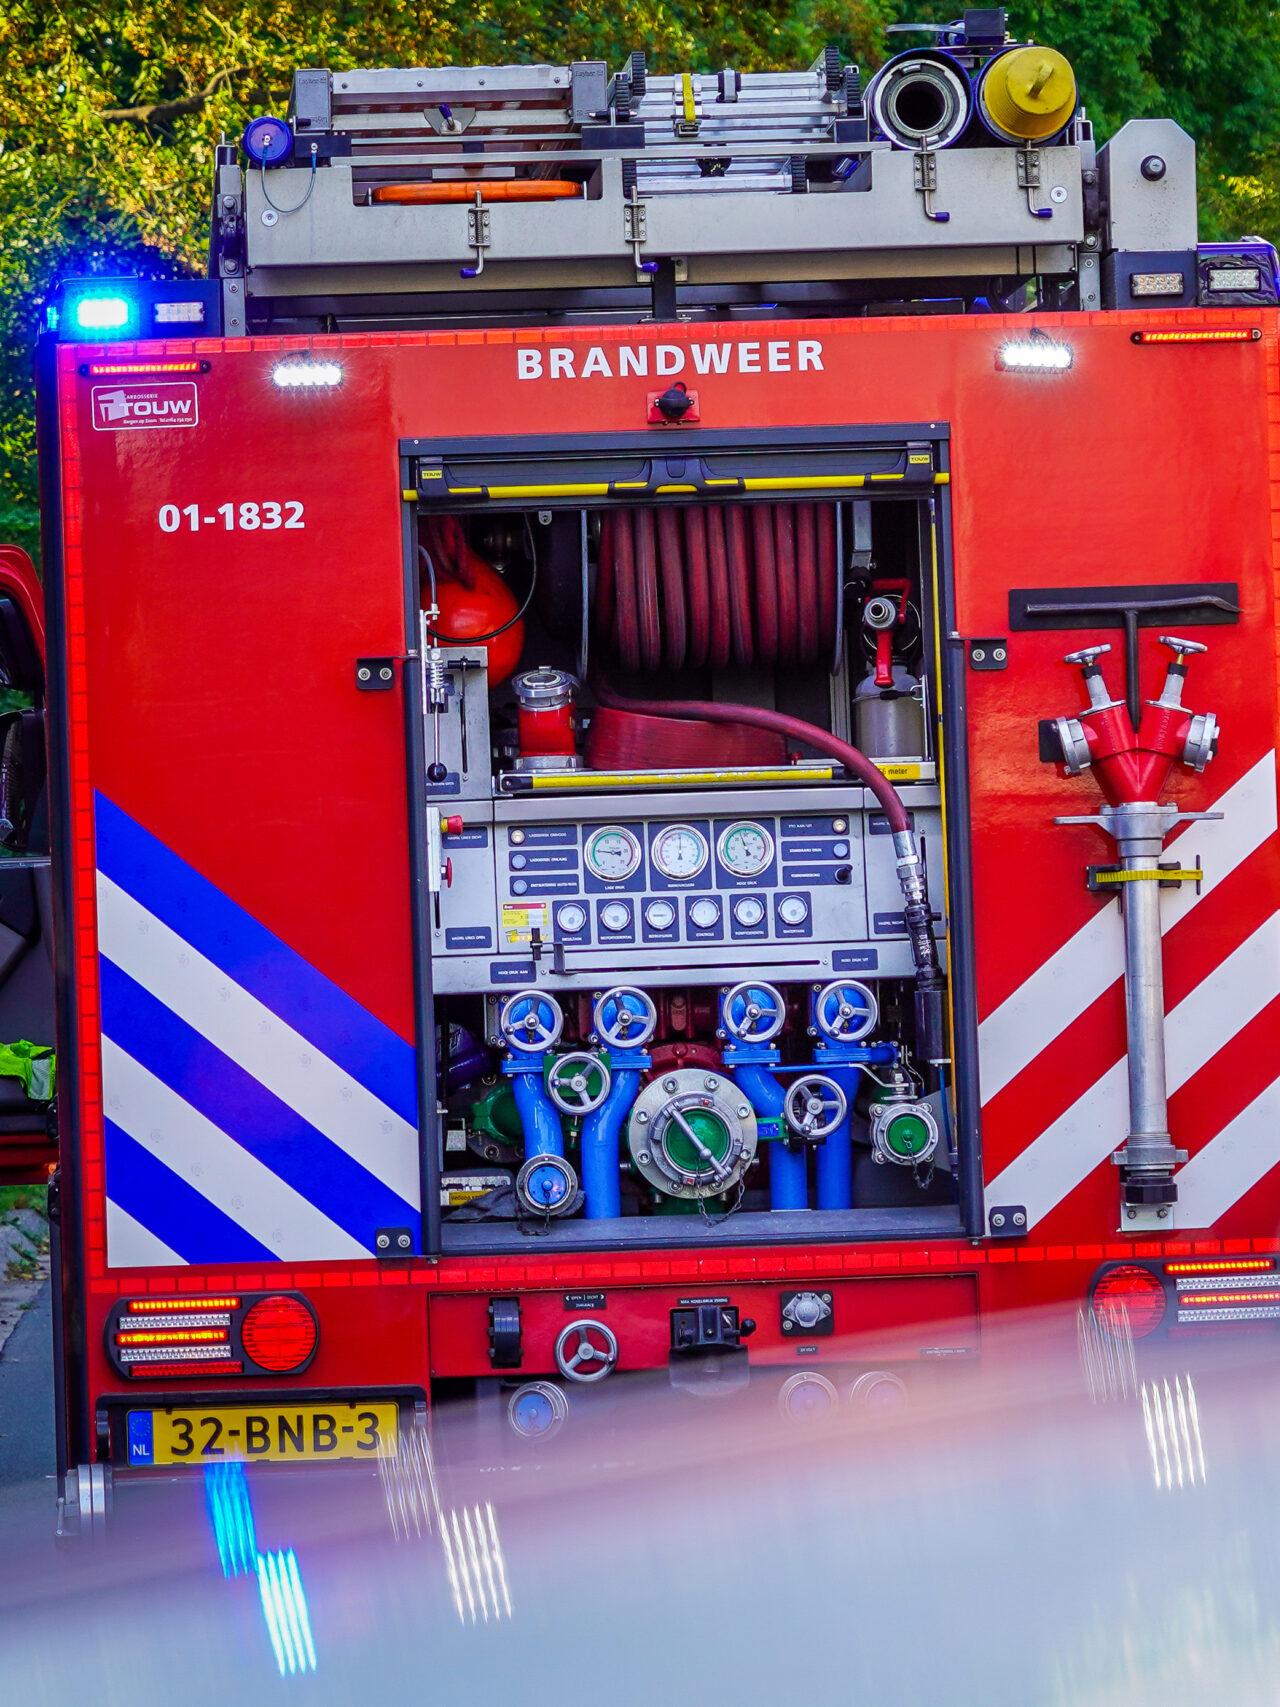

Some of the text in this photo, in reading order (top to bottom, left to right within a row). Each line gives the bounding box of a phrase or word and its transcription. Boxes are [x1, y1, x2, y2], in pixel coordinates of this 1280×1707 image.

[518, 340, 824, 380] BRANDWEER
[119, 400, 191, 415] TOUW
[158, 501, 305, 533] 01-1832
[888, 767, 907, 775] meter
[171, 1412, 379, 1456] 32-BNB-3
[132, 1444, 149, 1456] NL
